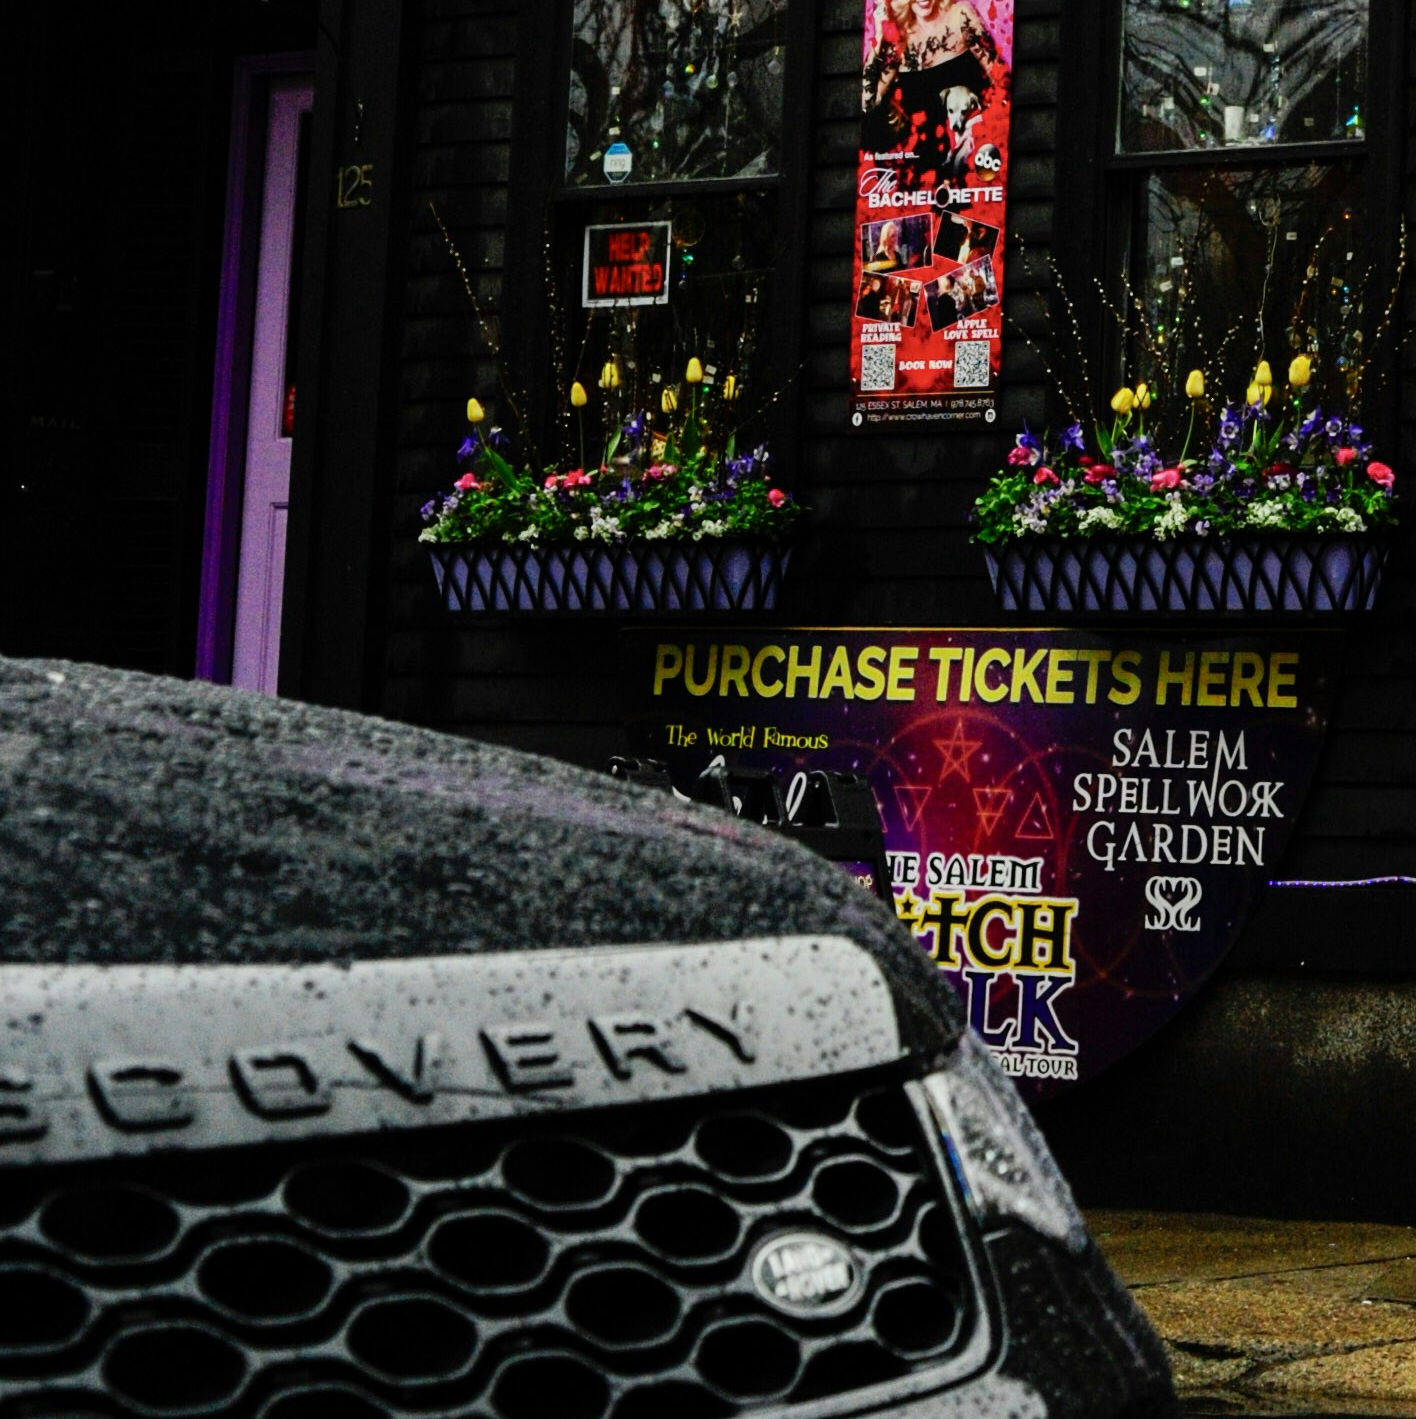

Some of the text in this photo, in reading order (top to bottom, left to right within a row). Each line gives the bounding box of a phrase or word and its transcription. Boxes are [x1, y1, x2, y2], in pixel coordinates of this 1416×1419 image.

[974, 152, 1002, 172] abc
[336, 163, 375, 209] 125
[860, 167, 898, 197] The
[868, 184, 1003, 209] BACHELORETTE
[607, 230, 652, 262] HELP
[862, 322, 901, 333] PRIVATE
[943, 328, 999, 340] LOVE SPELL
[957, 319, 987, 329] APPLE
[860, 332, 902, 343] READING
[899, 359, 953, 371] BOOK NOW
[868, 401, 890, 411] ESSEX
[930, 399, 943, 409] MA
[653, 643, 1299, 708] PURCHASE TICKETS HERE
[665, 723, 829, 750] The World Famous
[1111, 727, 1249, 770] SALEM
[1086, 820, 1266, 871] GARDEN
[928, 854, 1042, 889] SALEM
[1026, 1057, 1076, 1077] TOUR
